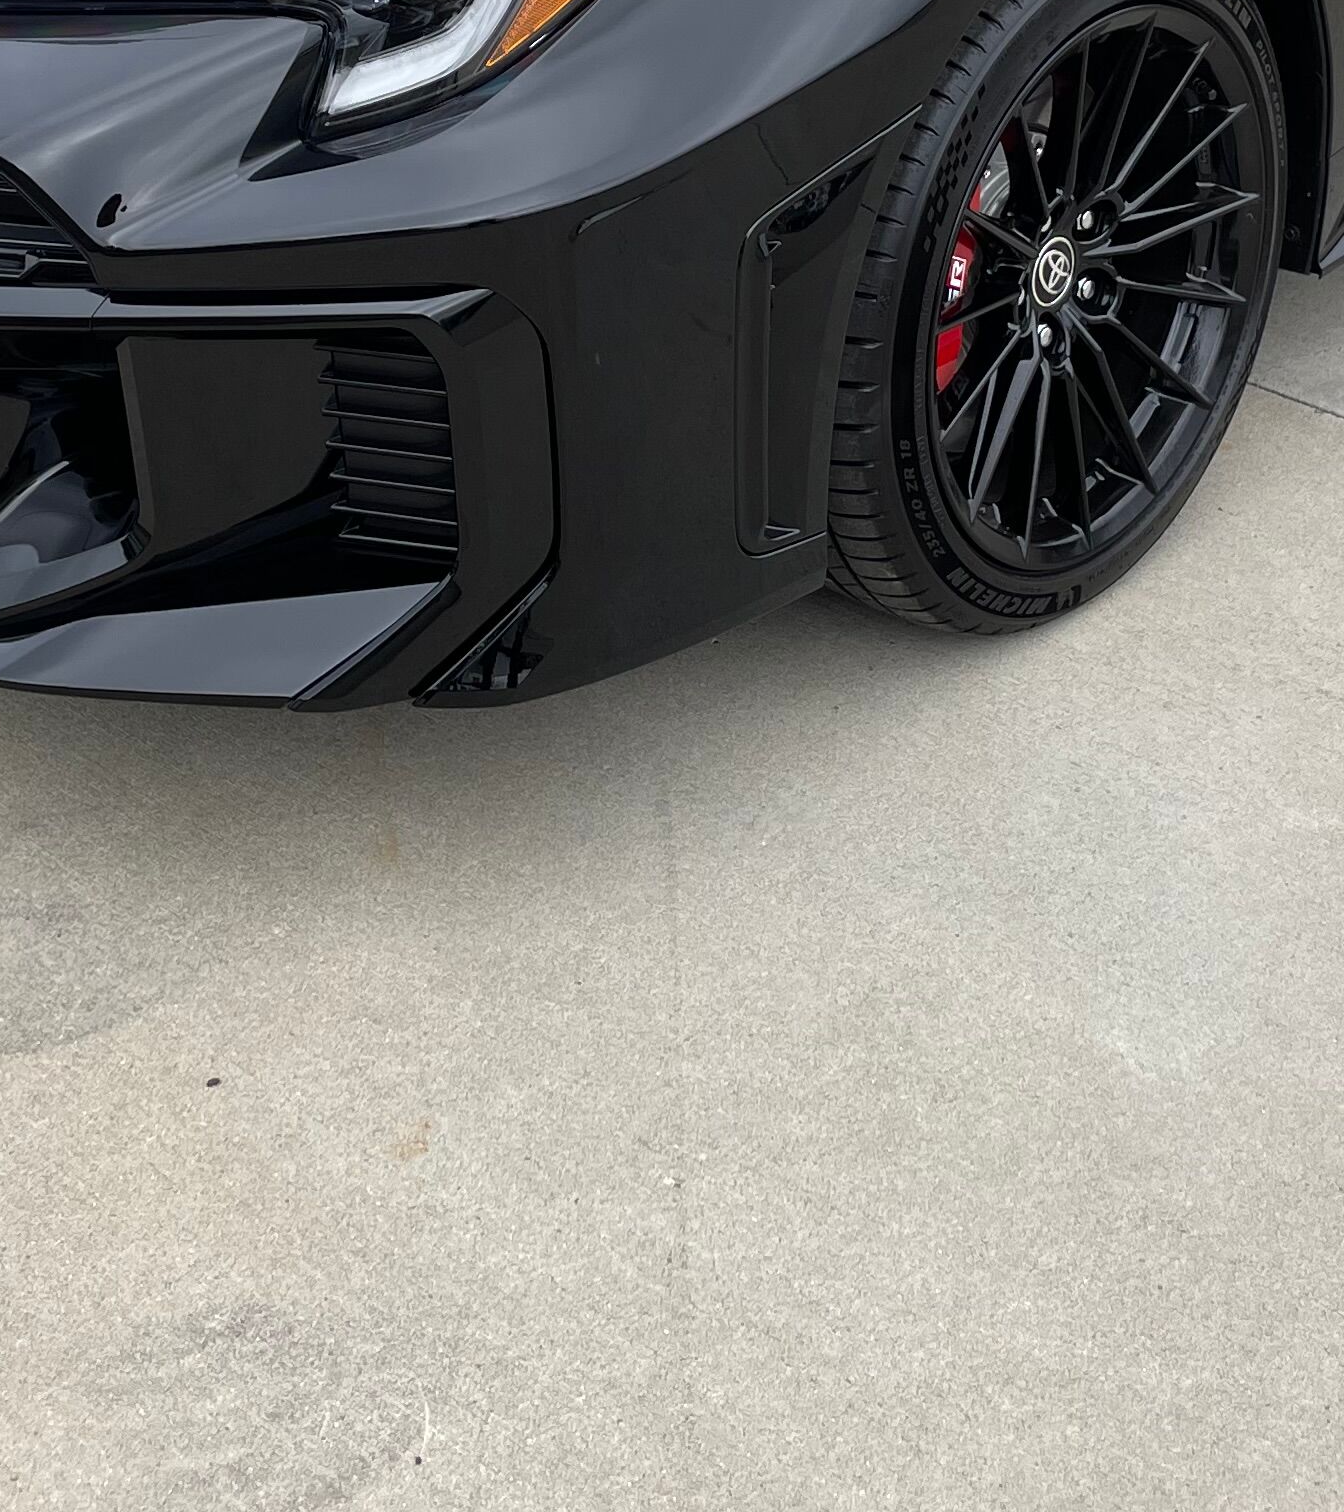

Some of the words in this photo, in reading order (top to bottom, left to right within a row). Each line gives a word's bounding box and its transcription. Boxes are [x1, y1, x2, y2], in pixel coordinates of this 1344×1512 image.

[1254, 39, 1276, 86] PILOT
[897, 439, 910, 460] 18
[903, 466, 920, 492] ZR
[910, 498, 947, 558] 235/40
[946, 567, 1056, 616] MICHELIN
